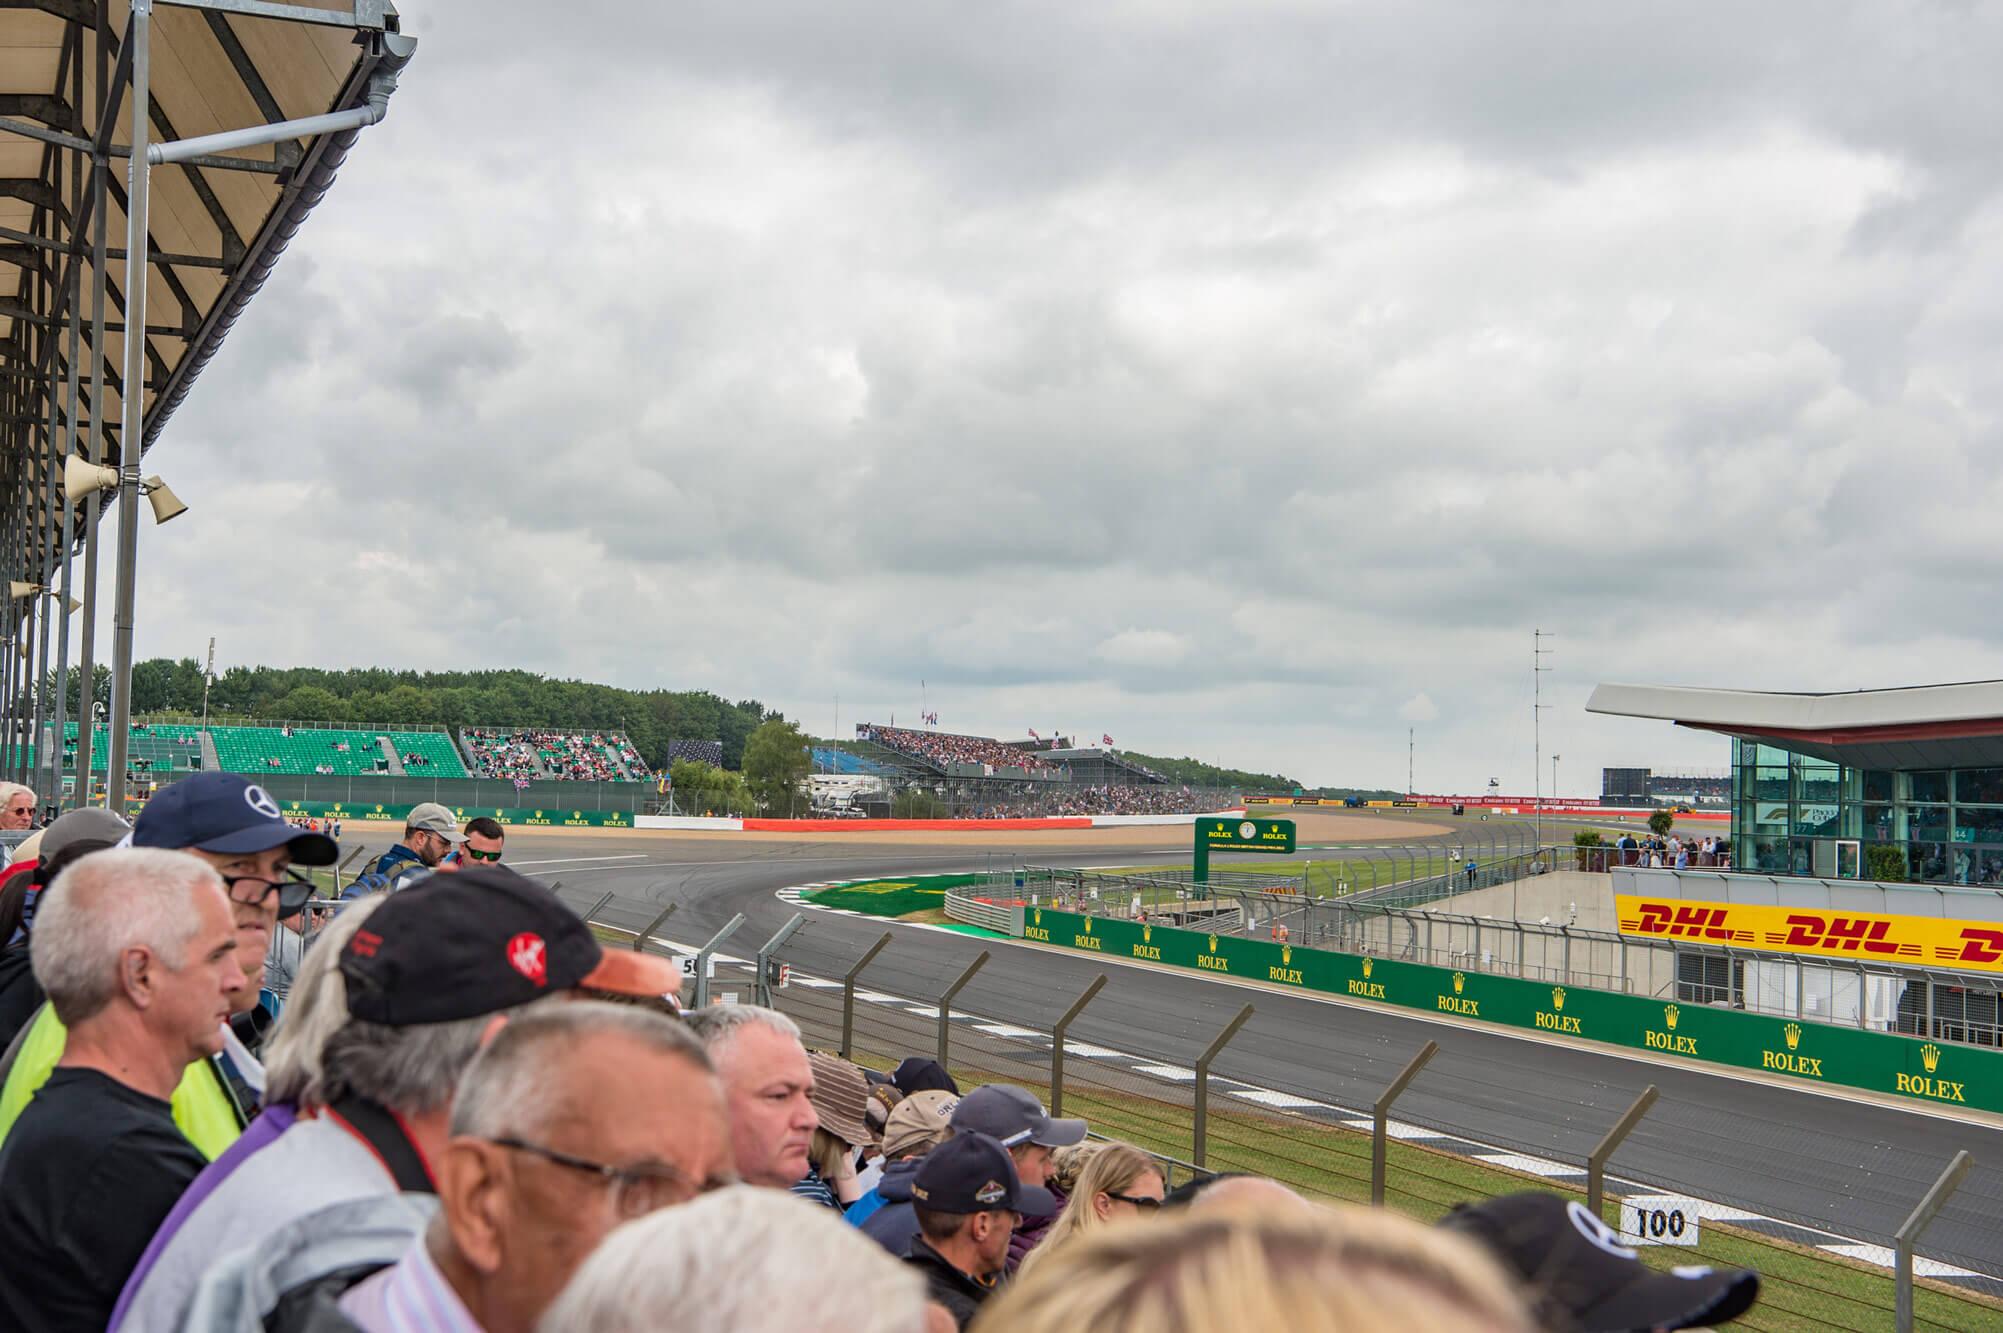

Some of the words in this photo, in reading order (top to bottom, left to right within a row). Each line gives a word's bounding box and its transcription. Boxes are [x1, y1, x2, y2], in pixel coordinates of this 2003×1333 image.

[281, 809, 309, 817] ROLEX
[1639, 904, 1735, 940] DHL
[1026, 927, 1049, 941] ROLEX
[1075, 935, 1100, 949] ROLEX
[1786, 915, 1899, 954] DHL
[1133, 944, 1160, 960] ROLEX
[1198, 955, 1227, 971] ROLEX
[1269, 967, 1301, 983] ROLEX
[1348, 980, 1384, 998] ROLEX
[1438, 995, 1478, 1015] ROLEX
[1535, 1011, 1581, 1034] ROLEX
[1645, 1030, 1697, 1055] ROLEX
[1763, 1051, 1822, 1077] ROLEX
[1896, 1072, 1964, 1102] ROLEX
[1638, 1209, 1685, 1237] 100
